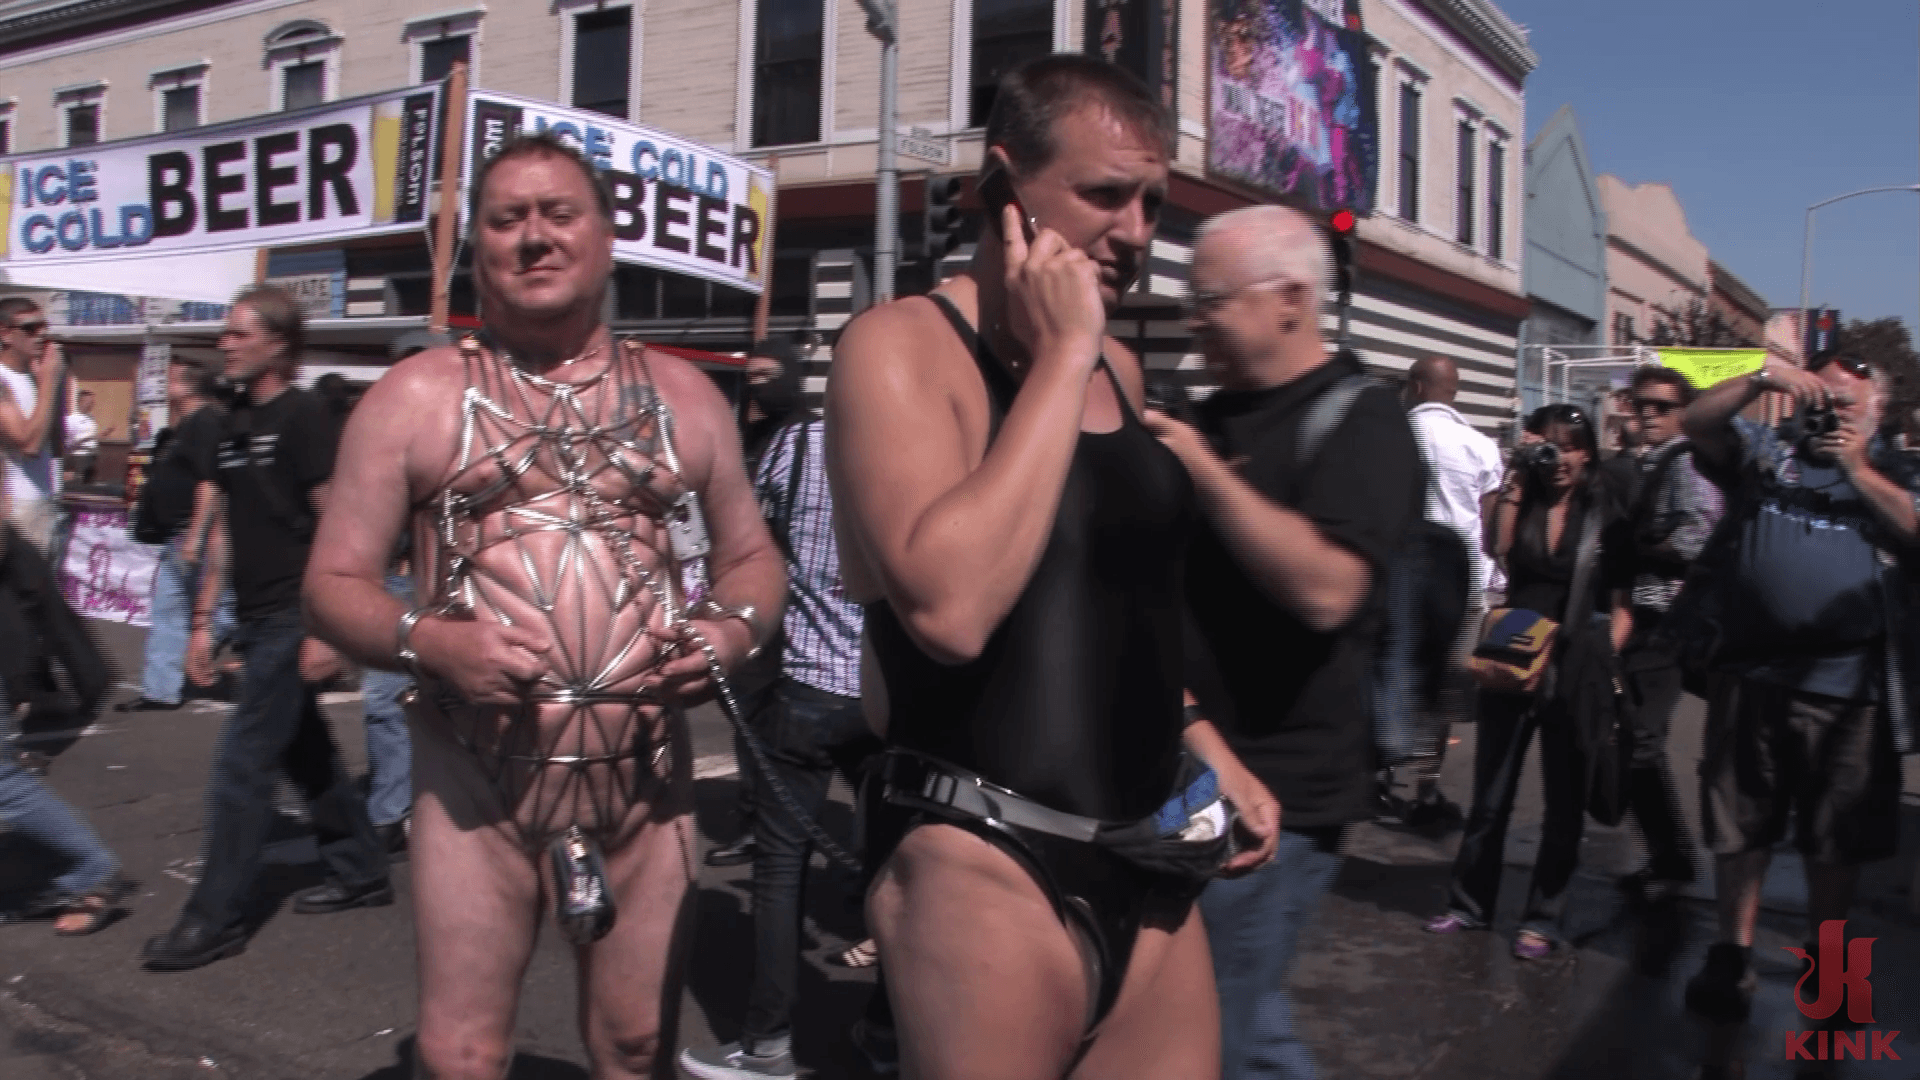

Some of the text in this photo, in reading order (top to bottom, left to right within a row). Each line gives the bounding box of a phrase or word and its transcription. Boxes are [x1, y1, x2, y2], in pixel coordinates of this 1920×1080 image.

[20, 158, 99, 208] ICE
[147, 121, 363, 240] BEER
[632, 139, 731, 201] COLD
[20, 202, 156, 255] COLD
[600, 169, 762, 276] BEER
